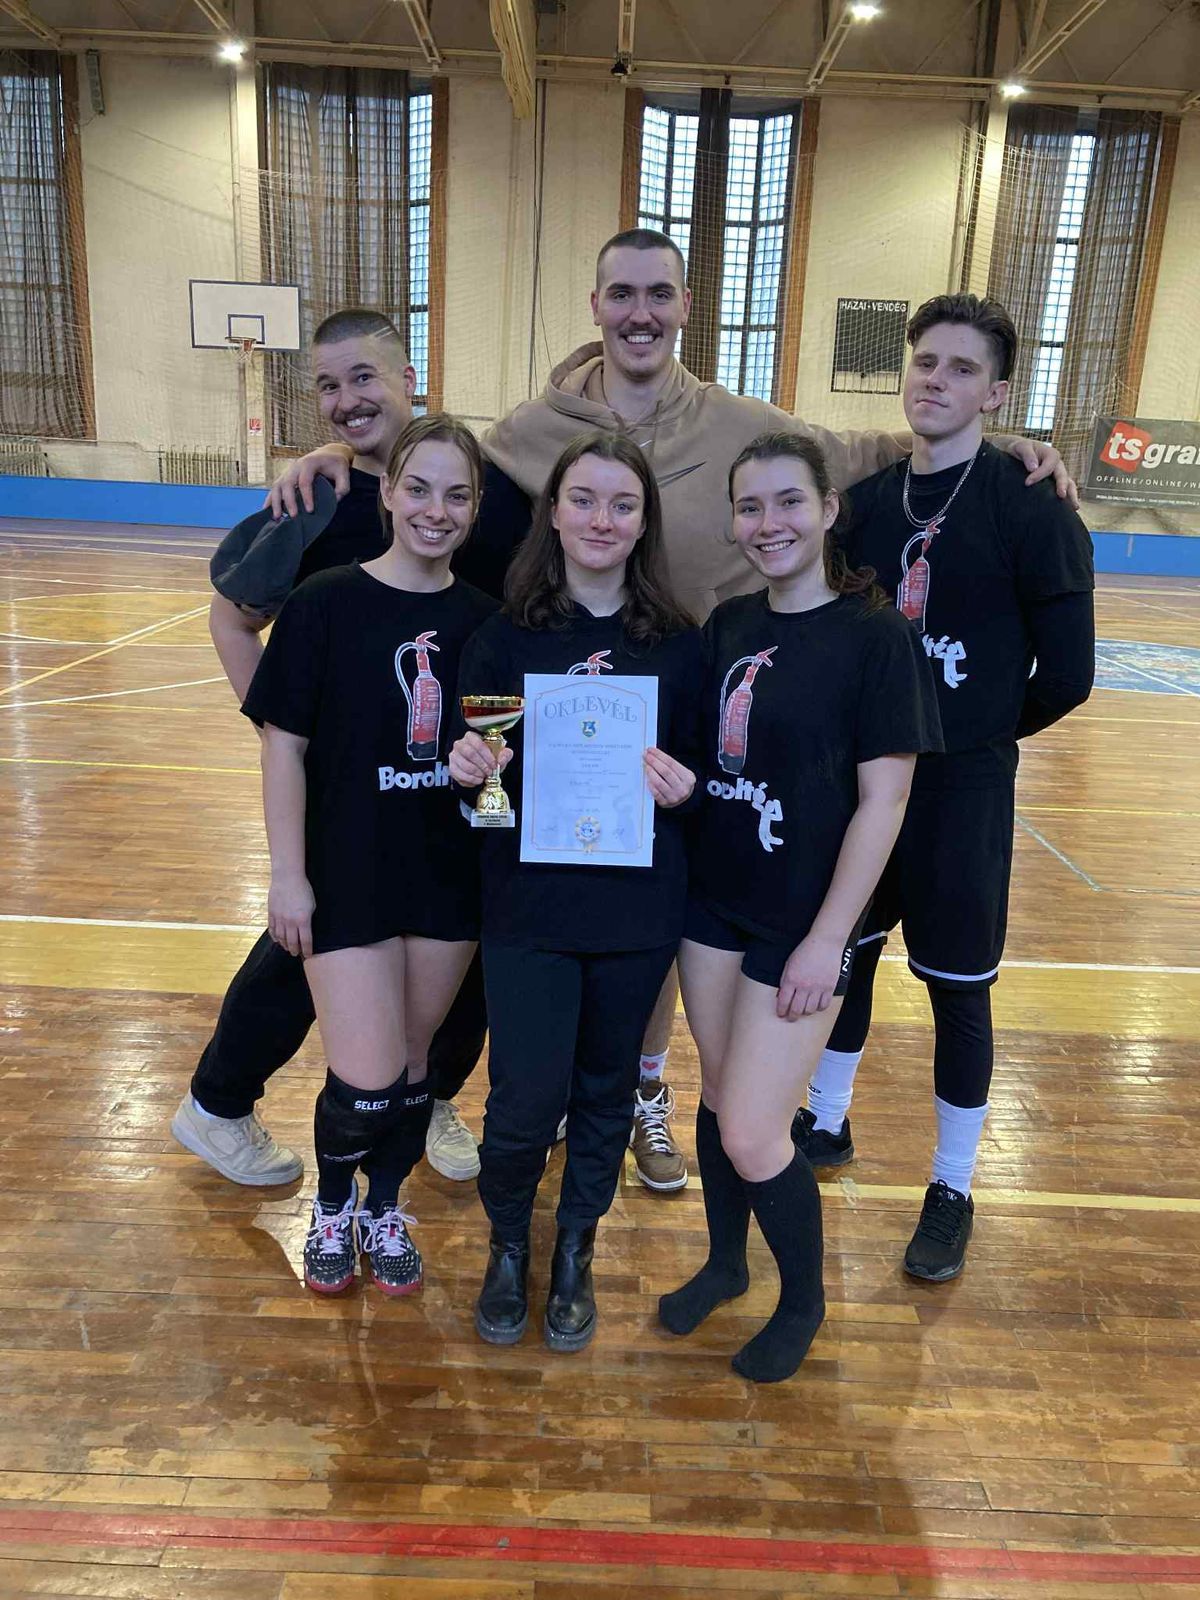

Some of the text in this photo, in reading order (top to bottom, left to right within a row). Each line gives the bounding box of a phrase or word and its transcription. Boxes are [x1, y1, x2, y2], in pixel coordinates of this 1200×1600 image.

[841, 301, 867, 311] HAZAI
[1108, 432, 1200, 469] tsgra
[544, 695, 638, 722] OKLEVÉL
[378, 761, 449, 791] Borolt
[354, 1100, 390, 1111] SELECT
[404, 1093, 429, 1106] ELECT
